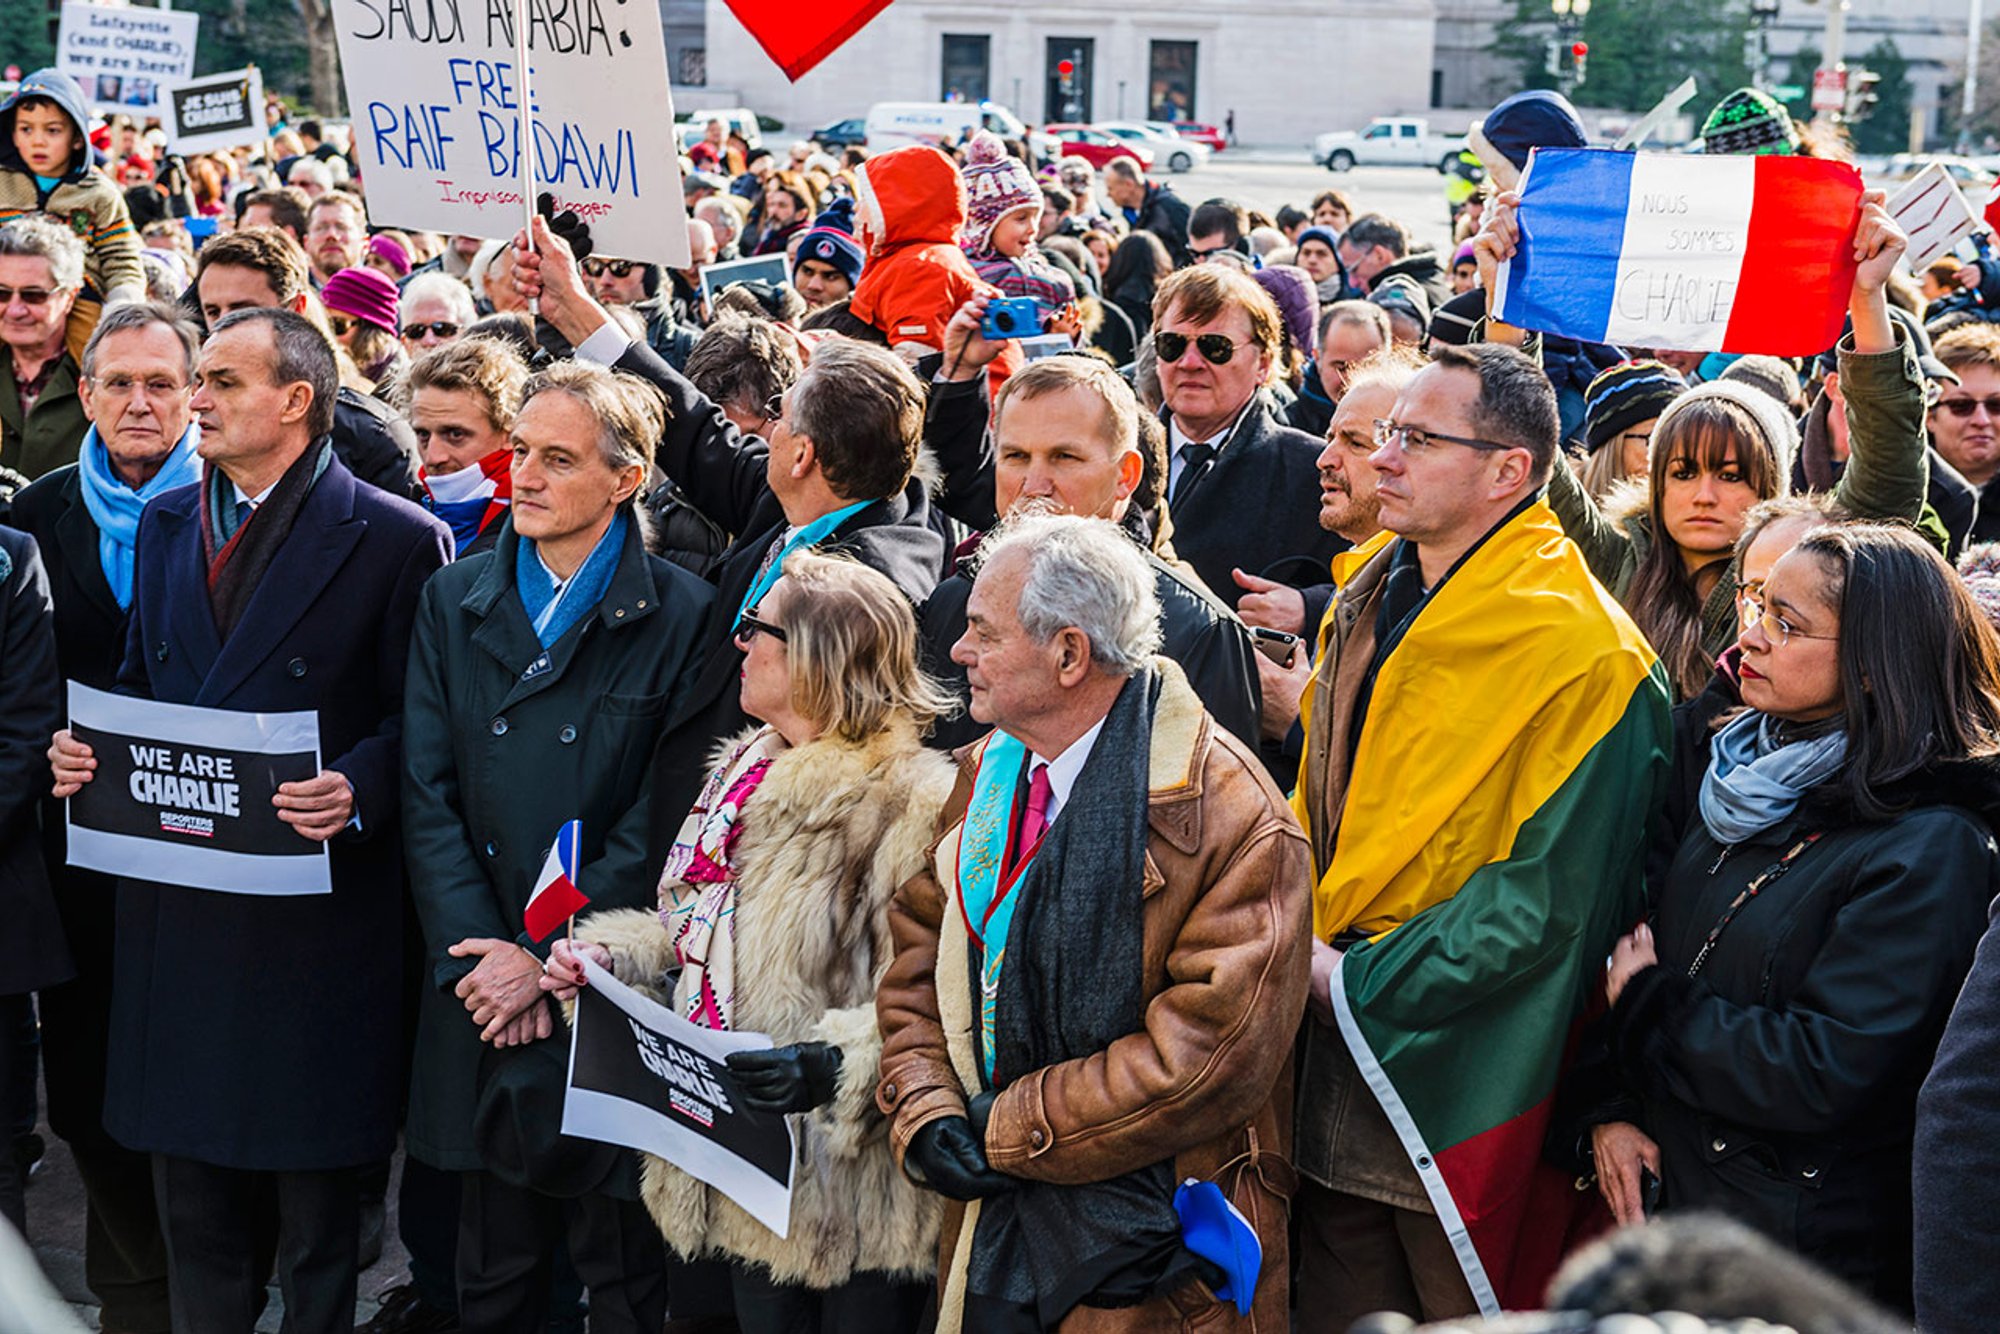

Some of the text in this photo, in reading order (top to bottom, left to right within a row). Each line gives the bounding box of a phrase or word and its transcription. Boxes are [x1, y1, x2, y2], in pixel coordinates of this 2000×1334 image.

[90, 14, 170, 32] Lafayette
[352, 0, 464, 43] SAUDI
[69, 54, 185, 75] we are here!
[181, 88, 241, 112] JE SUIS
[182, 102, 244, 128] CHARLIE
[369, 101, 454, 171] RAIF
[1641, 194, 1689, 214] NOUS
[1666, 228, 1735, 251] SOMMES
[129, 744, 235, 780] WE ARE
[129, 770, 240, 818] CHARLIE
[628, 1017, 715, 1080] WE ARE
[637, 1043, 733, 1114] CHARLIE
